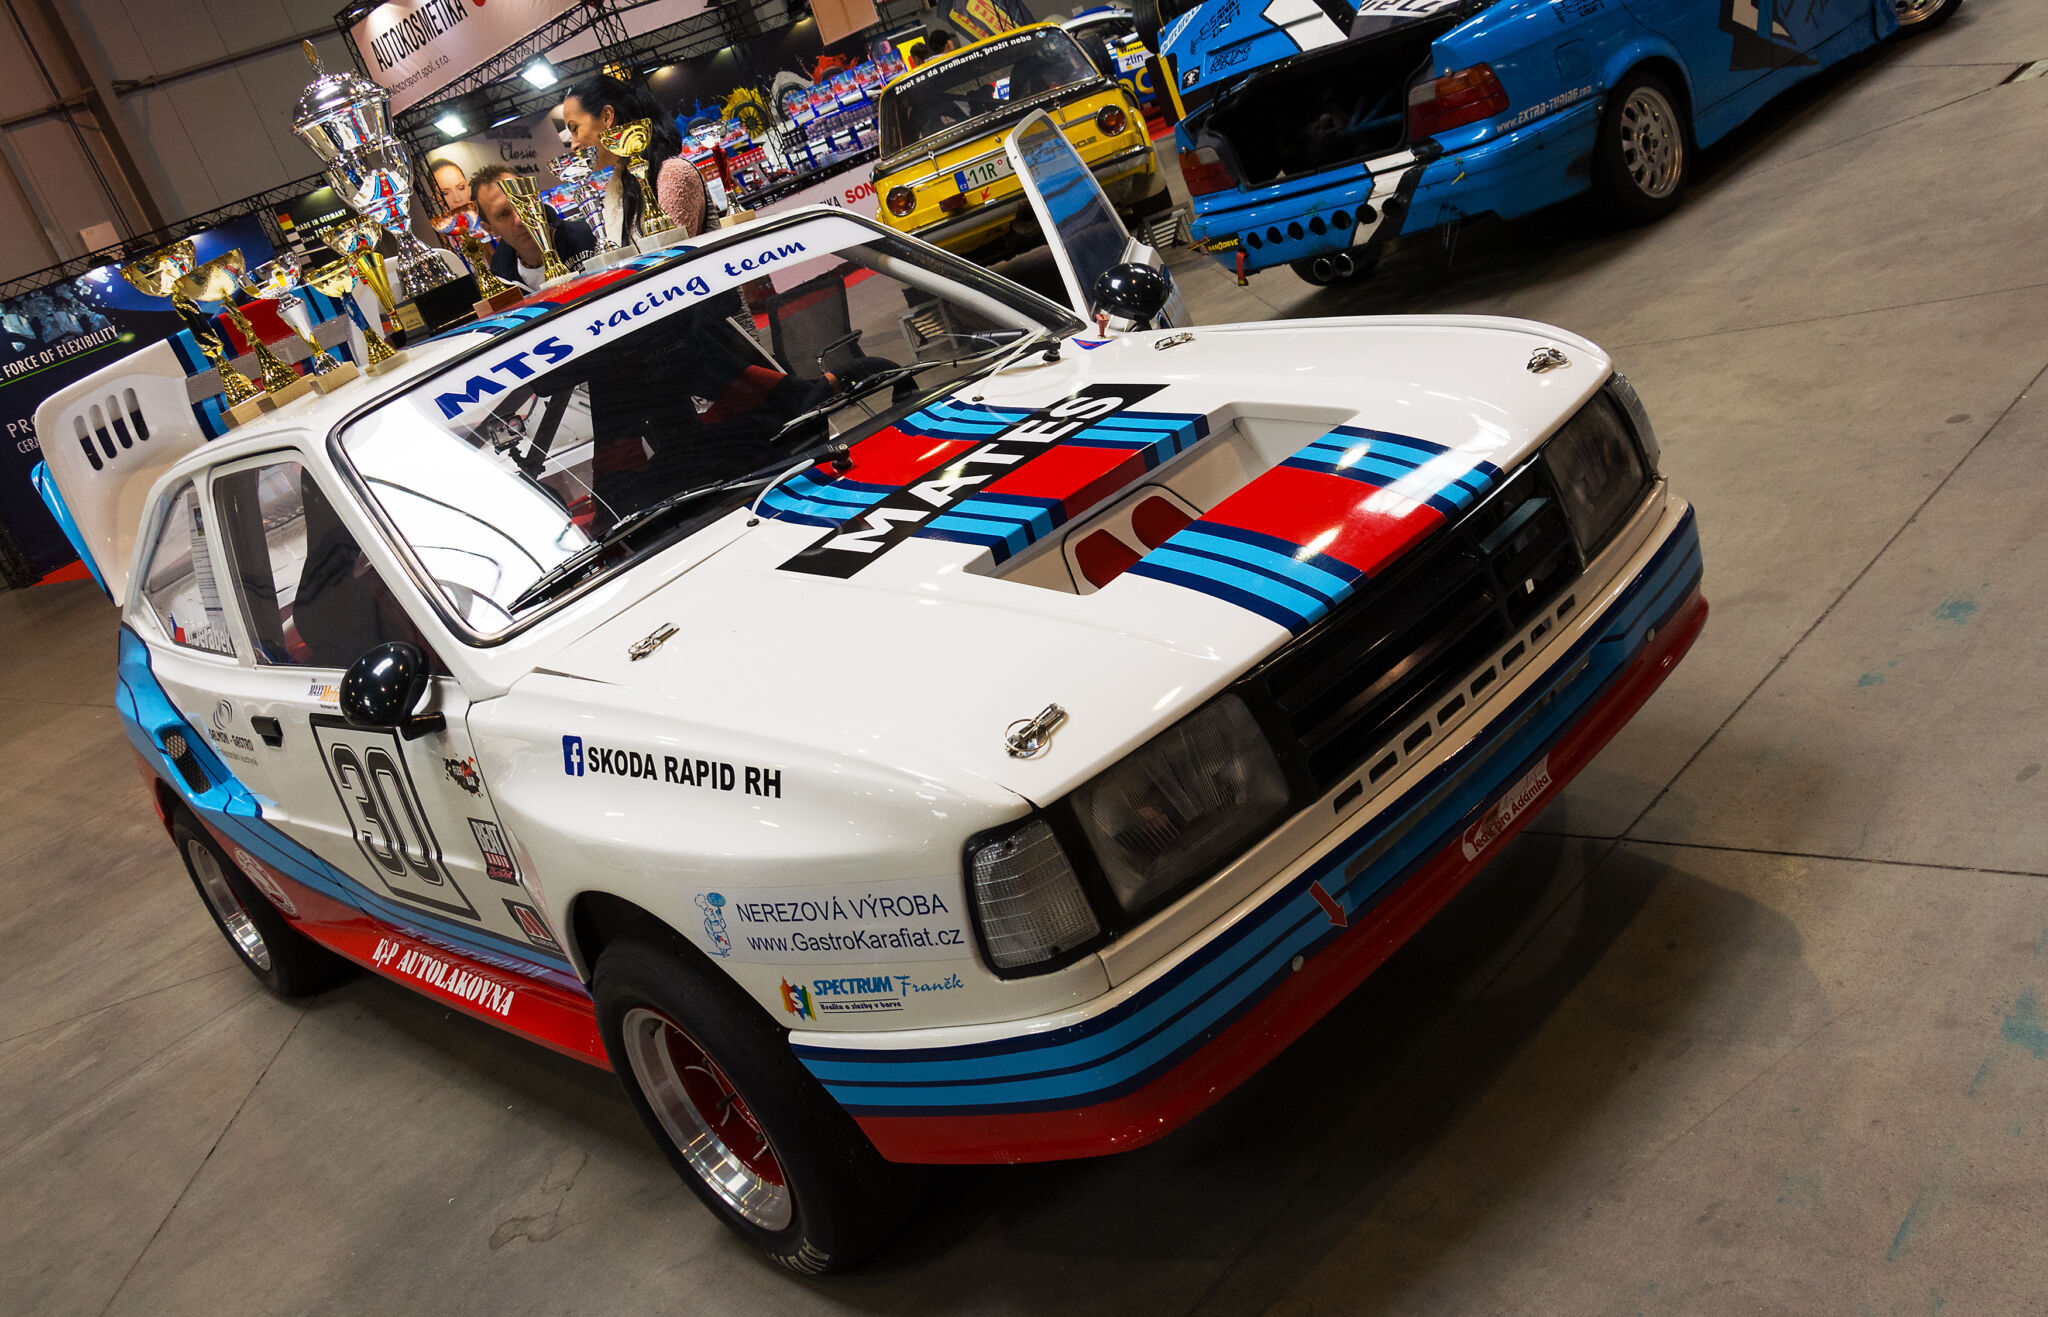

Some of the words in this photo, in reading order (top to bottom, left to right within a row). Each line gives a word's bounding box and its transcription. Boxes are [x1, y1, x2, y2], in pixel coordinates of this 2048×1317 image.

[371, 0, 468, 72] AUTOKOSMETIKA
[894, 79, 915, 95] Život
[916, 75, 926, 83] se
[927, 66, 938, 78] dá
[940, 51, 984, 73] promarnit,
[1010, 34, 1032, 46] nebo
[295, 221, 312, 232] MADE
[311, 218, 320, 226] IN
[319, 208, 347, 223] GERMANY
[3, 355, 40, 378] FORCE
[40, 348, 55, 364] OF
[56, 325, 119, 358] FLEXIBILITY
[435, 336, 574, 420] MTS
[586, 275, 712, 336] racing
[723, 240, 806, 277] team
[822, 396, 1124, 553] MATES
[588, 746, 658, 781] SKODA
[664, 756, 735, 791] RAPID
[745, 766, 782, 799] RH
[331, 743, 444, 886] 30
[736, 896, 848, 923] NEREZOVÁ
[848, 893, 949, 918] VÝROBA
[746, 928, 965, 952] www.GastroKarafiat.cz
[396, 949, 515, 1016] AUTOLAKOVNA
[813, 976, 893, 996] SPECTRUM
[893, 973, 965, 997] Franěk
